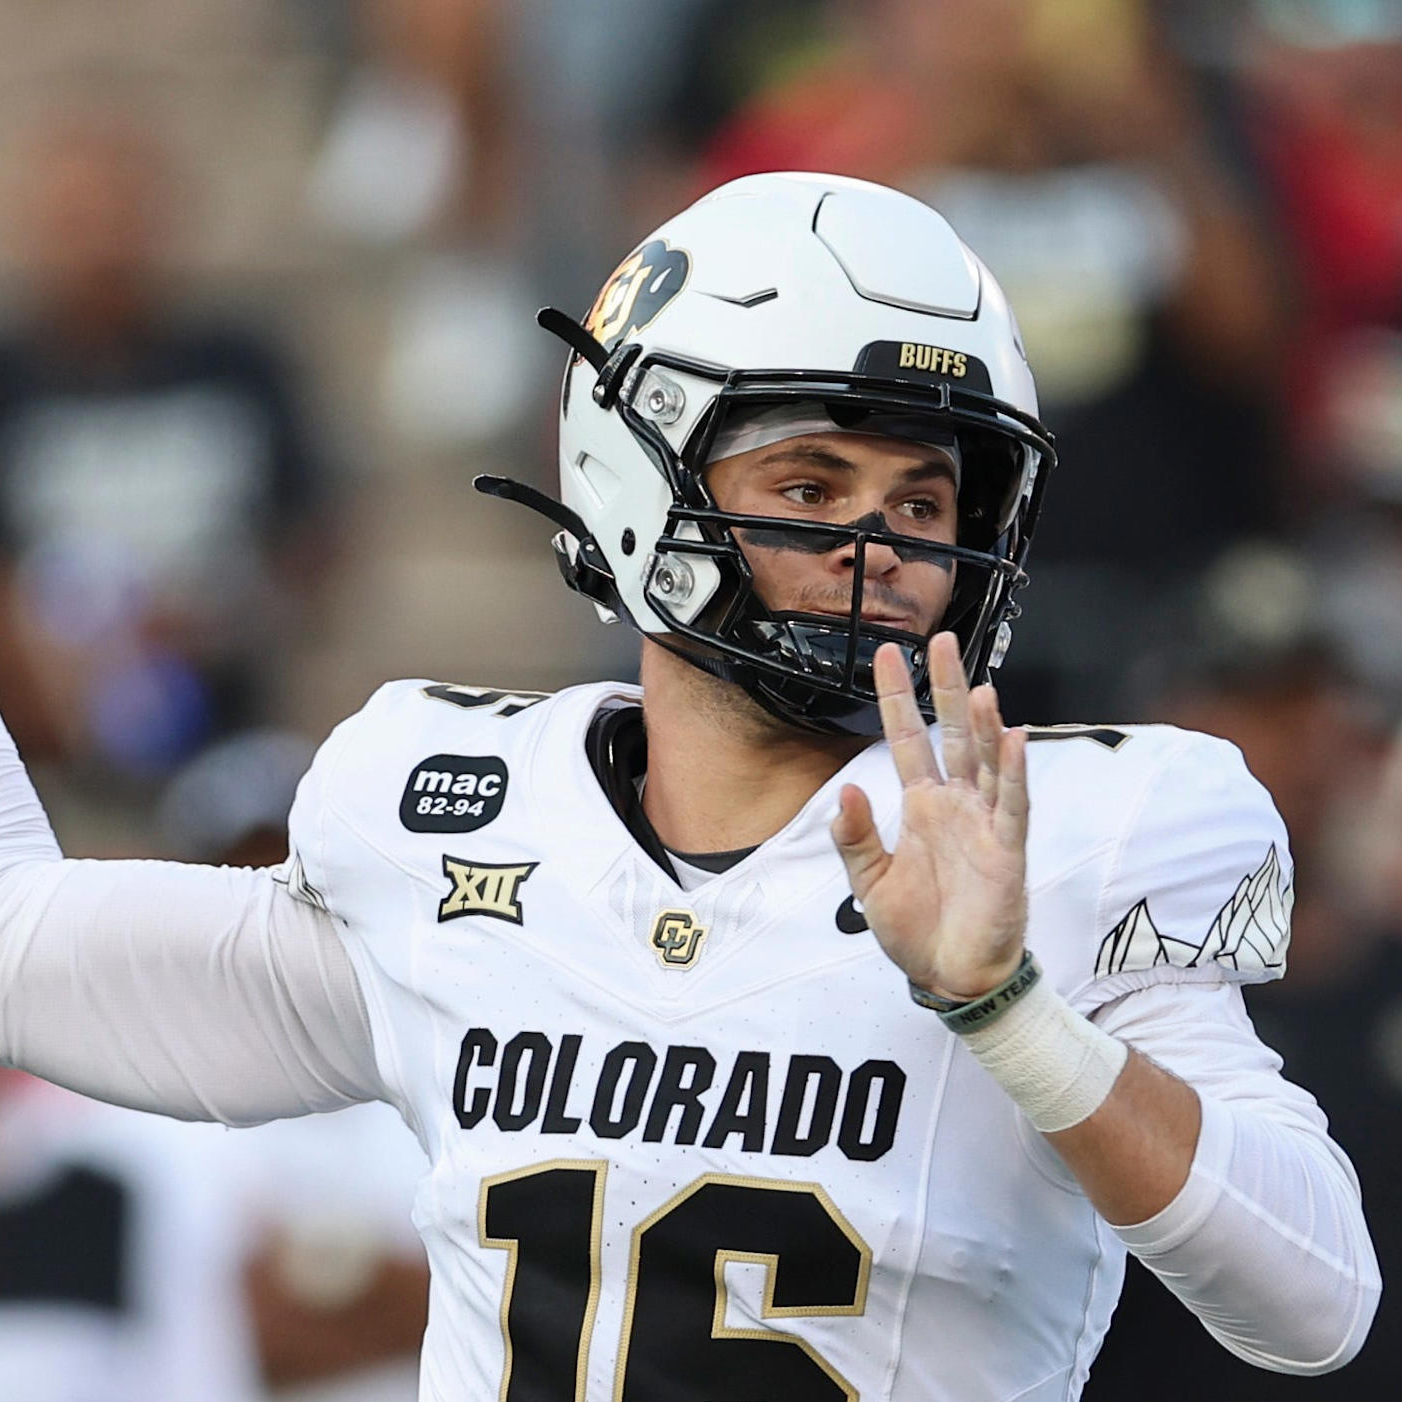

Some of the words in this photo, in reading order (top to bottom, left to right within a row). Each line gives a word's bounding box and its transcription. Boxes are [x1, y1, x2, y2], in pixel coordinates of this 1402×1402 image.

[899, 342, 969, 379] BUFFS
[413, 769, 502, 798] mac
[416, 796, 486, 817] 82-94
[438, 854, 540, 926] XII
[650, 909, 707, 968] CU
[959, 998, 997, 1025] NEW
[452, 1027, 907, 1162] COLORADO
